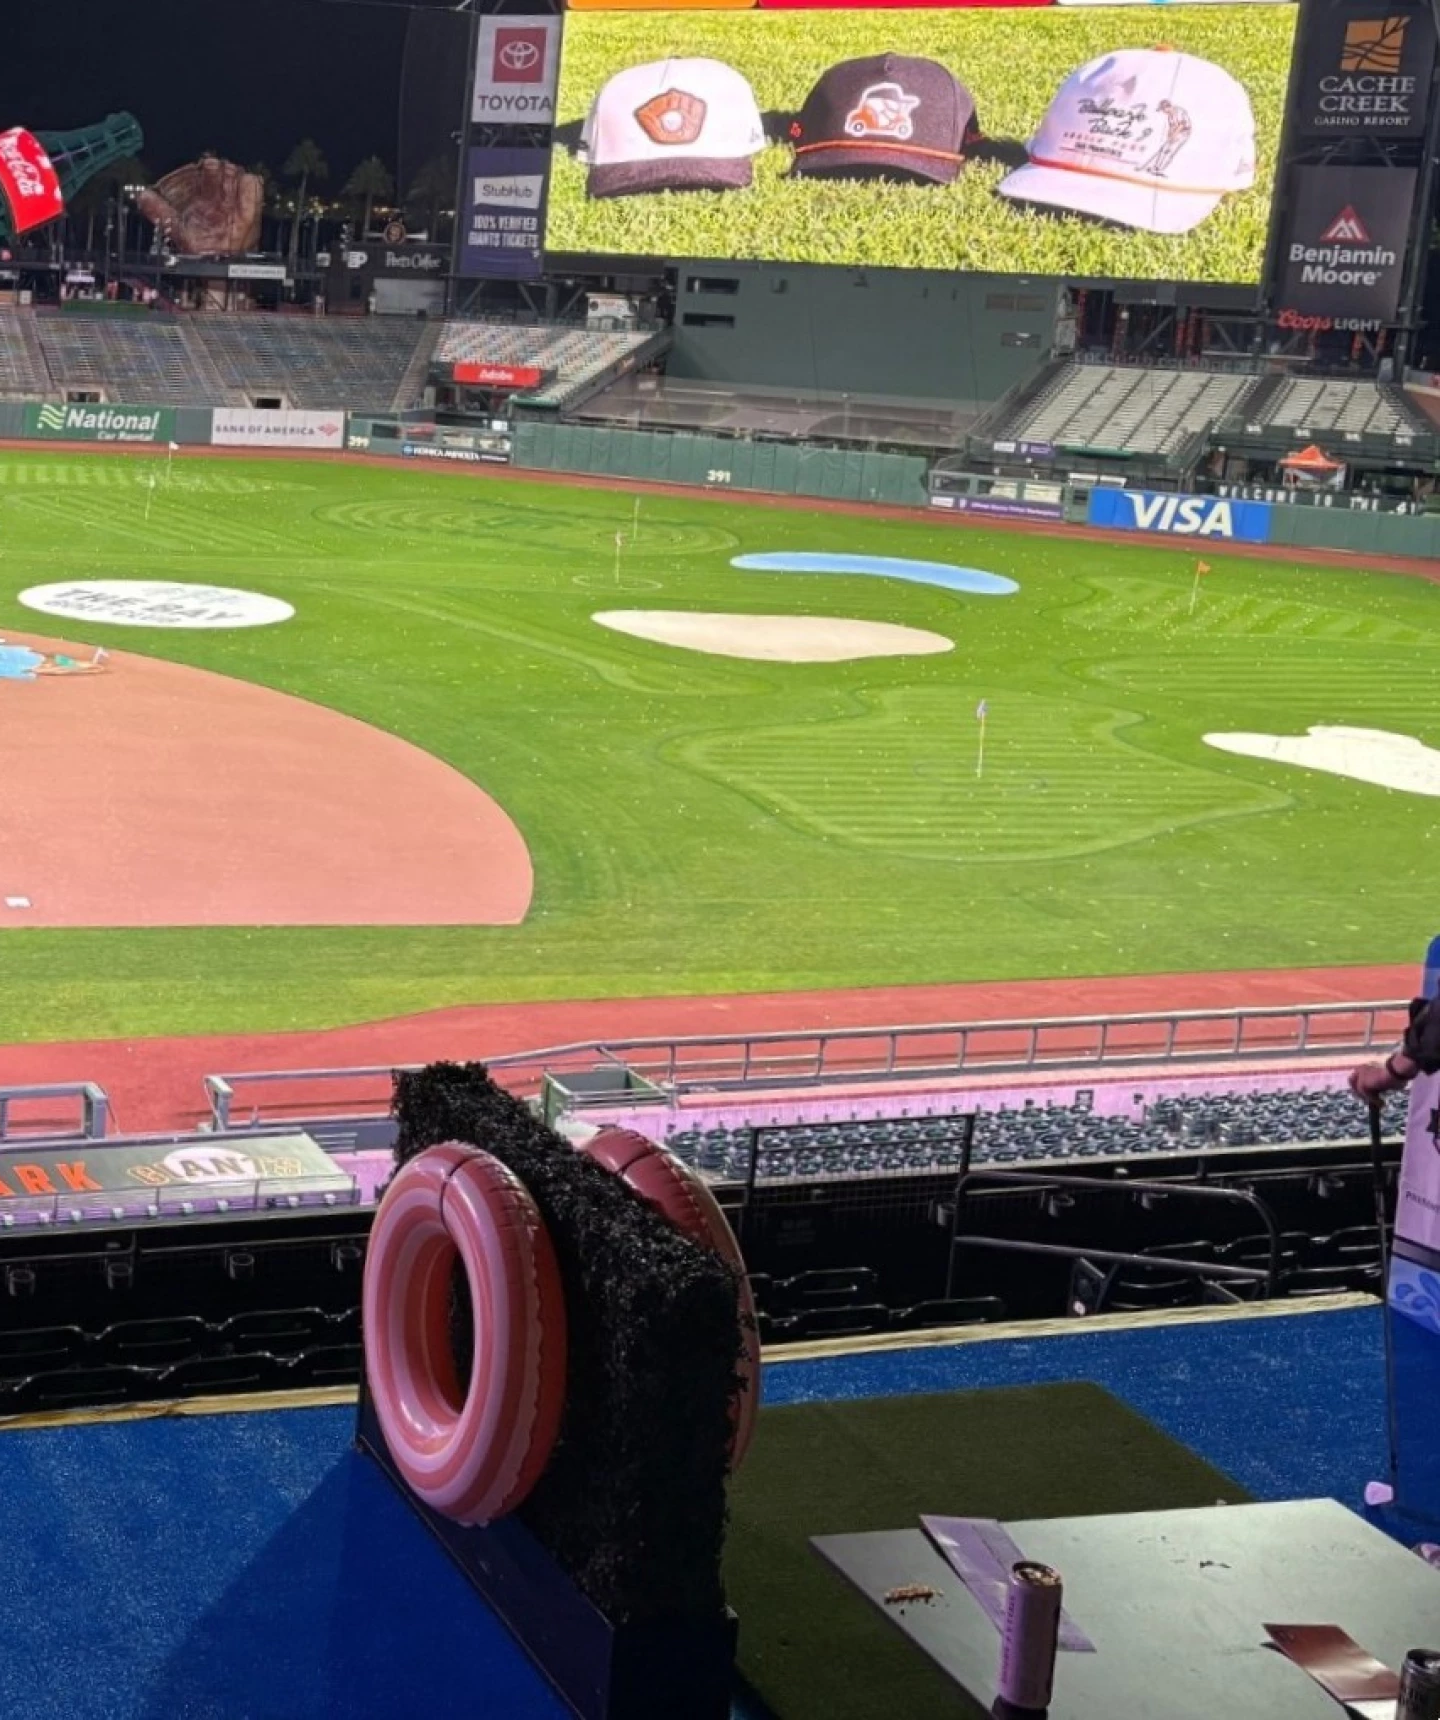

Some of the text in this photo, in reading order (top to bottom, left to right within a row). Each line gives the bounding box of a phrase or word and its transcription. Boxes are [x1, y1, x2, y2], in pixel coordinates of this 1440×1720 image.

[1319, 76, 1416, 93] CACHE
[478, 94, 552, 111] TOYOTA
[1319, 95, 1409, 112] CREEK
[1314, 116, 1411, 126] CASINO RESORT
[483, 183, 534, 199] StubHub
[473, 215, 538, 231] 100% VERIFIED
[468, 231, 539, 248] GIANTS TICKETS
[1289, 243, 1396, 268] Benjamin
[1301, 264, 1377, 285] Moore
[1277, 308, 1382, 332] Coors LIGHT
[478, 368, 515, 382] Adobe
[65, 408, 160, 431] National
[215, 423, 315, 436] BANK OF AMERICA
[707, 470, 732, 483] 391
[1124, 492, 1233, 538] VISA
[127, 1155, 302, 1187] GIANTS
